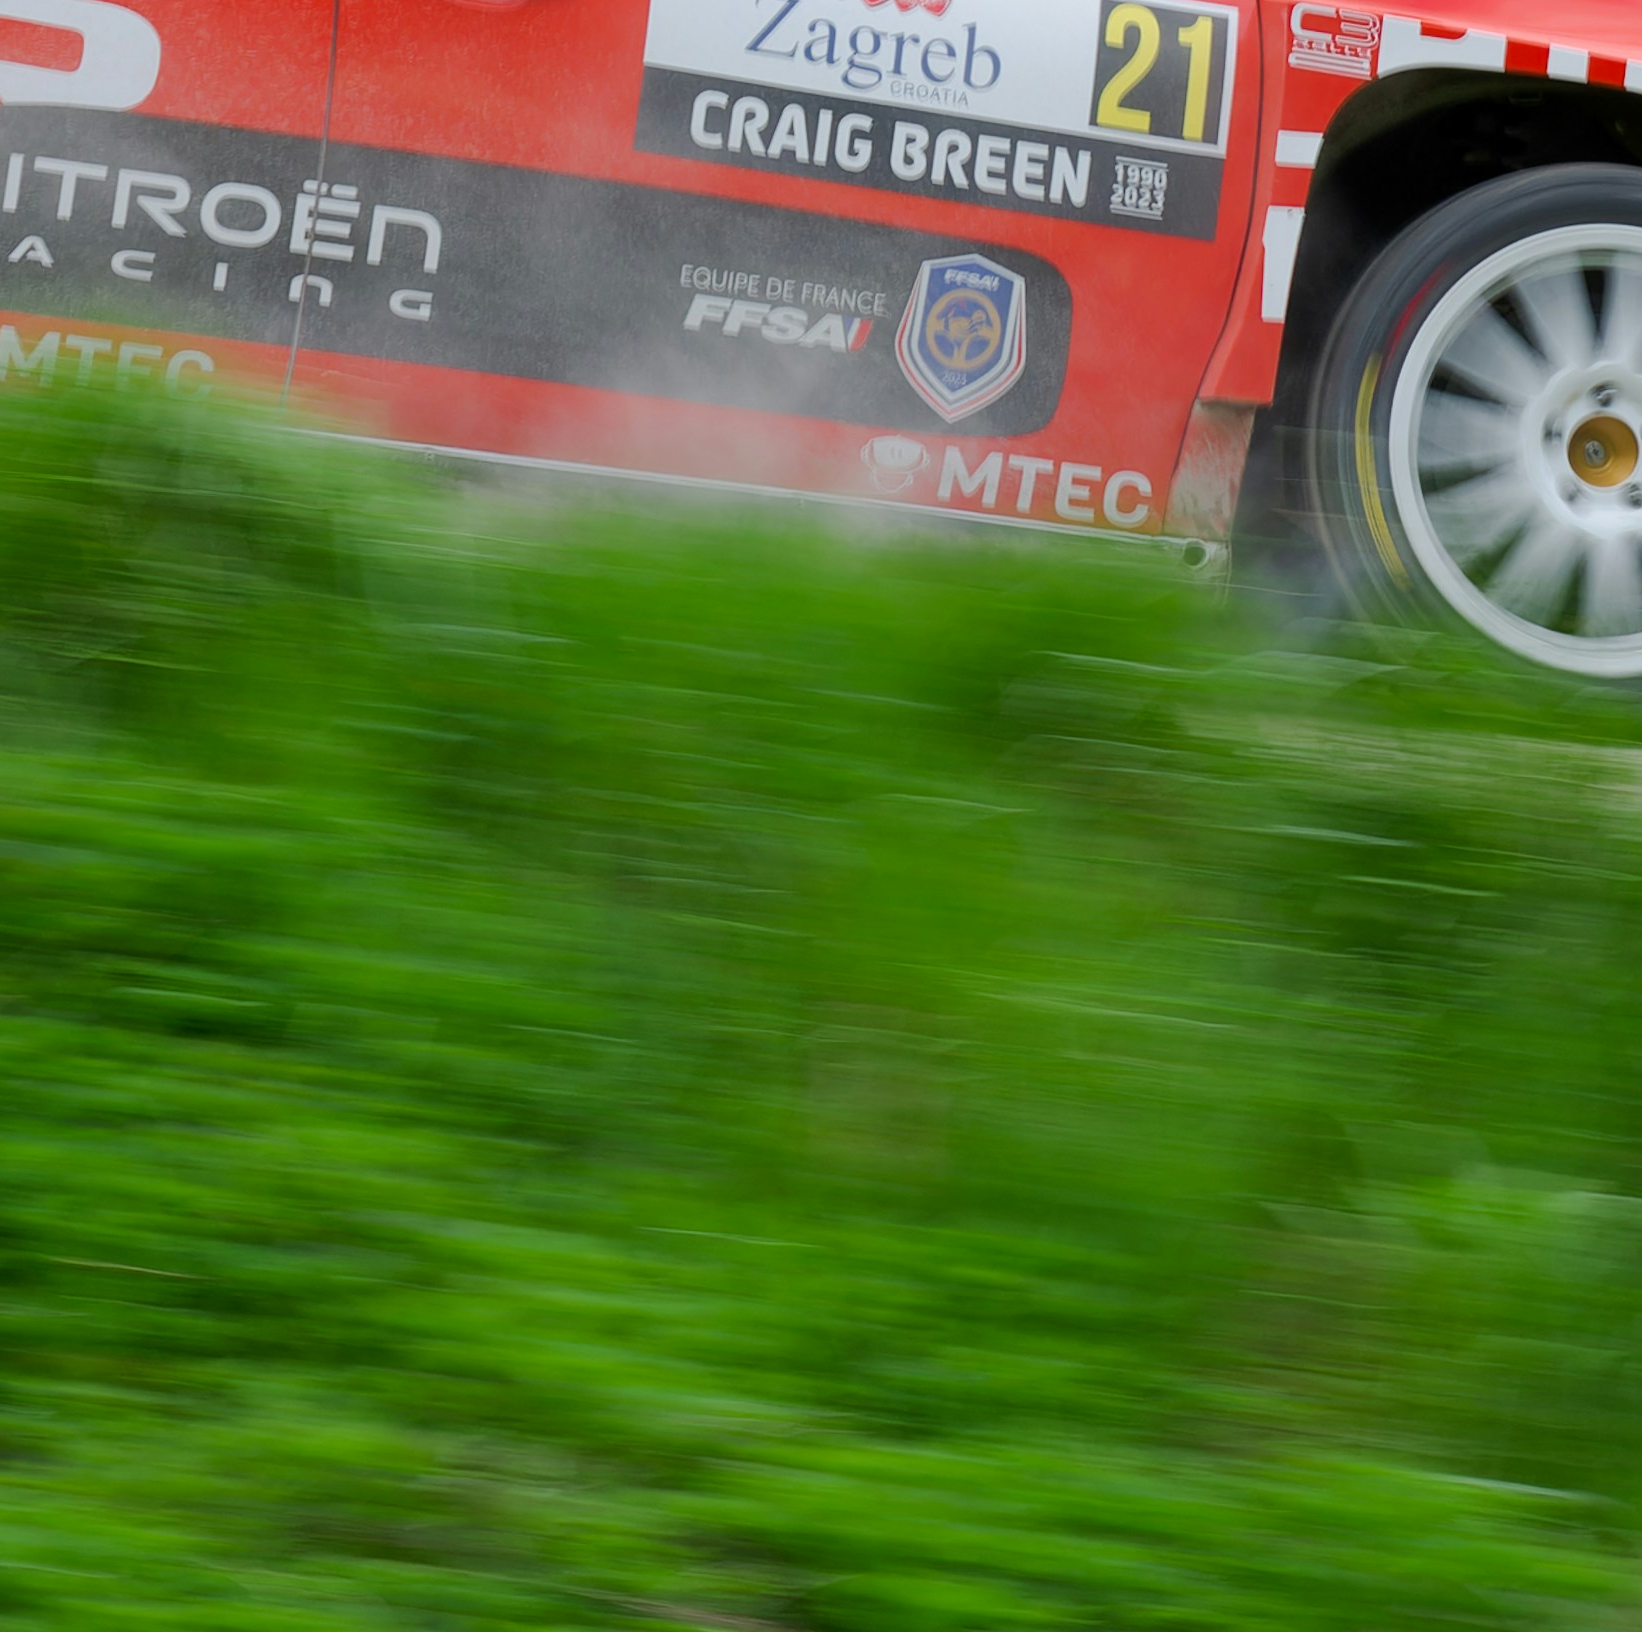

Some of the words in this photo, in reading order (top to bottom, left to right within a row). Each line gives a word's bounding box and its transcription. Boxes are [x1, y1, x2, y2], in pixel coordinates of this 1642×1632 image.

[889, 80, 969, 107] CROATIA
[1096, 2, 1213, 141] 21
[690, 89, 874, 173] CRAIG
[890, 121, 1091, 208] BREEN
[1111, 183, 1165, 211] 2023
[1115, 163, 1168, 192] 1990
[680, 264, 760, 298] EQUIPE
[766, 277, 796, 303] DE
[801, 282, 890, 318] FRANCE
[683, 293, 849, 353] FFSA
[936, 445, 1152, 528] MTEC
